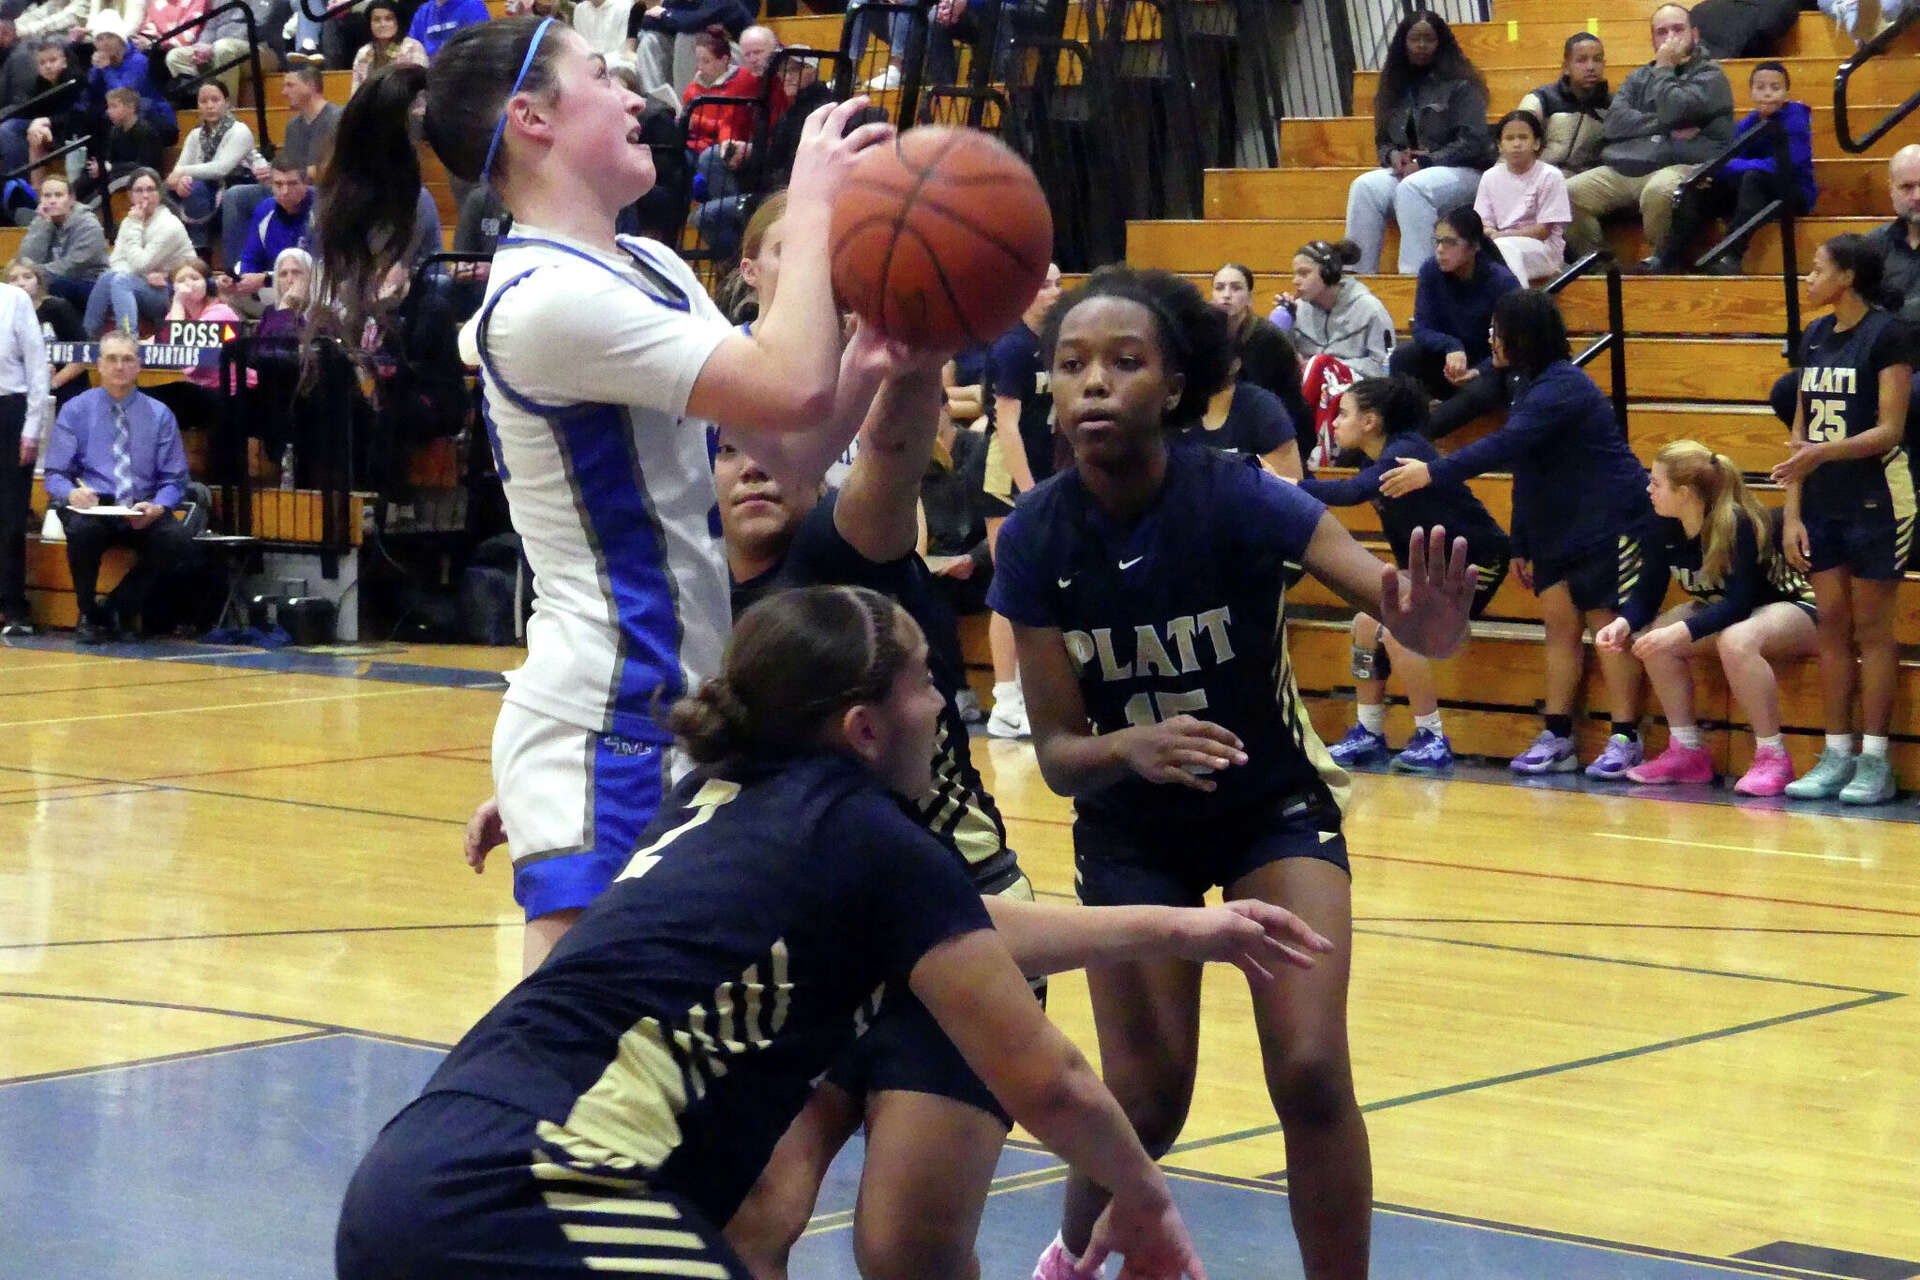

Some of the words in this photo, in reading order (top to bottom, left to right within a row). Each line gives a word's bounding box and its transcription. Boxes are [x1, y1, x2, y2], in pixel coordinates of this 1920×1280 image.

[170, 322, 223, 348] POSS.
[144, 345, 200, 366] SPARTANS
[1808, 398, 1847, 442] 25
[1063, 606, 1236, 681] PLATT
